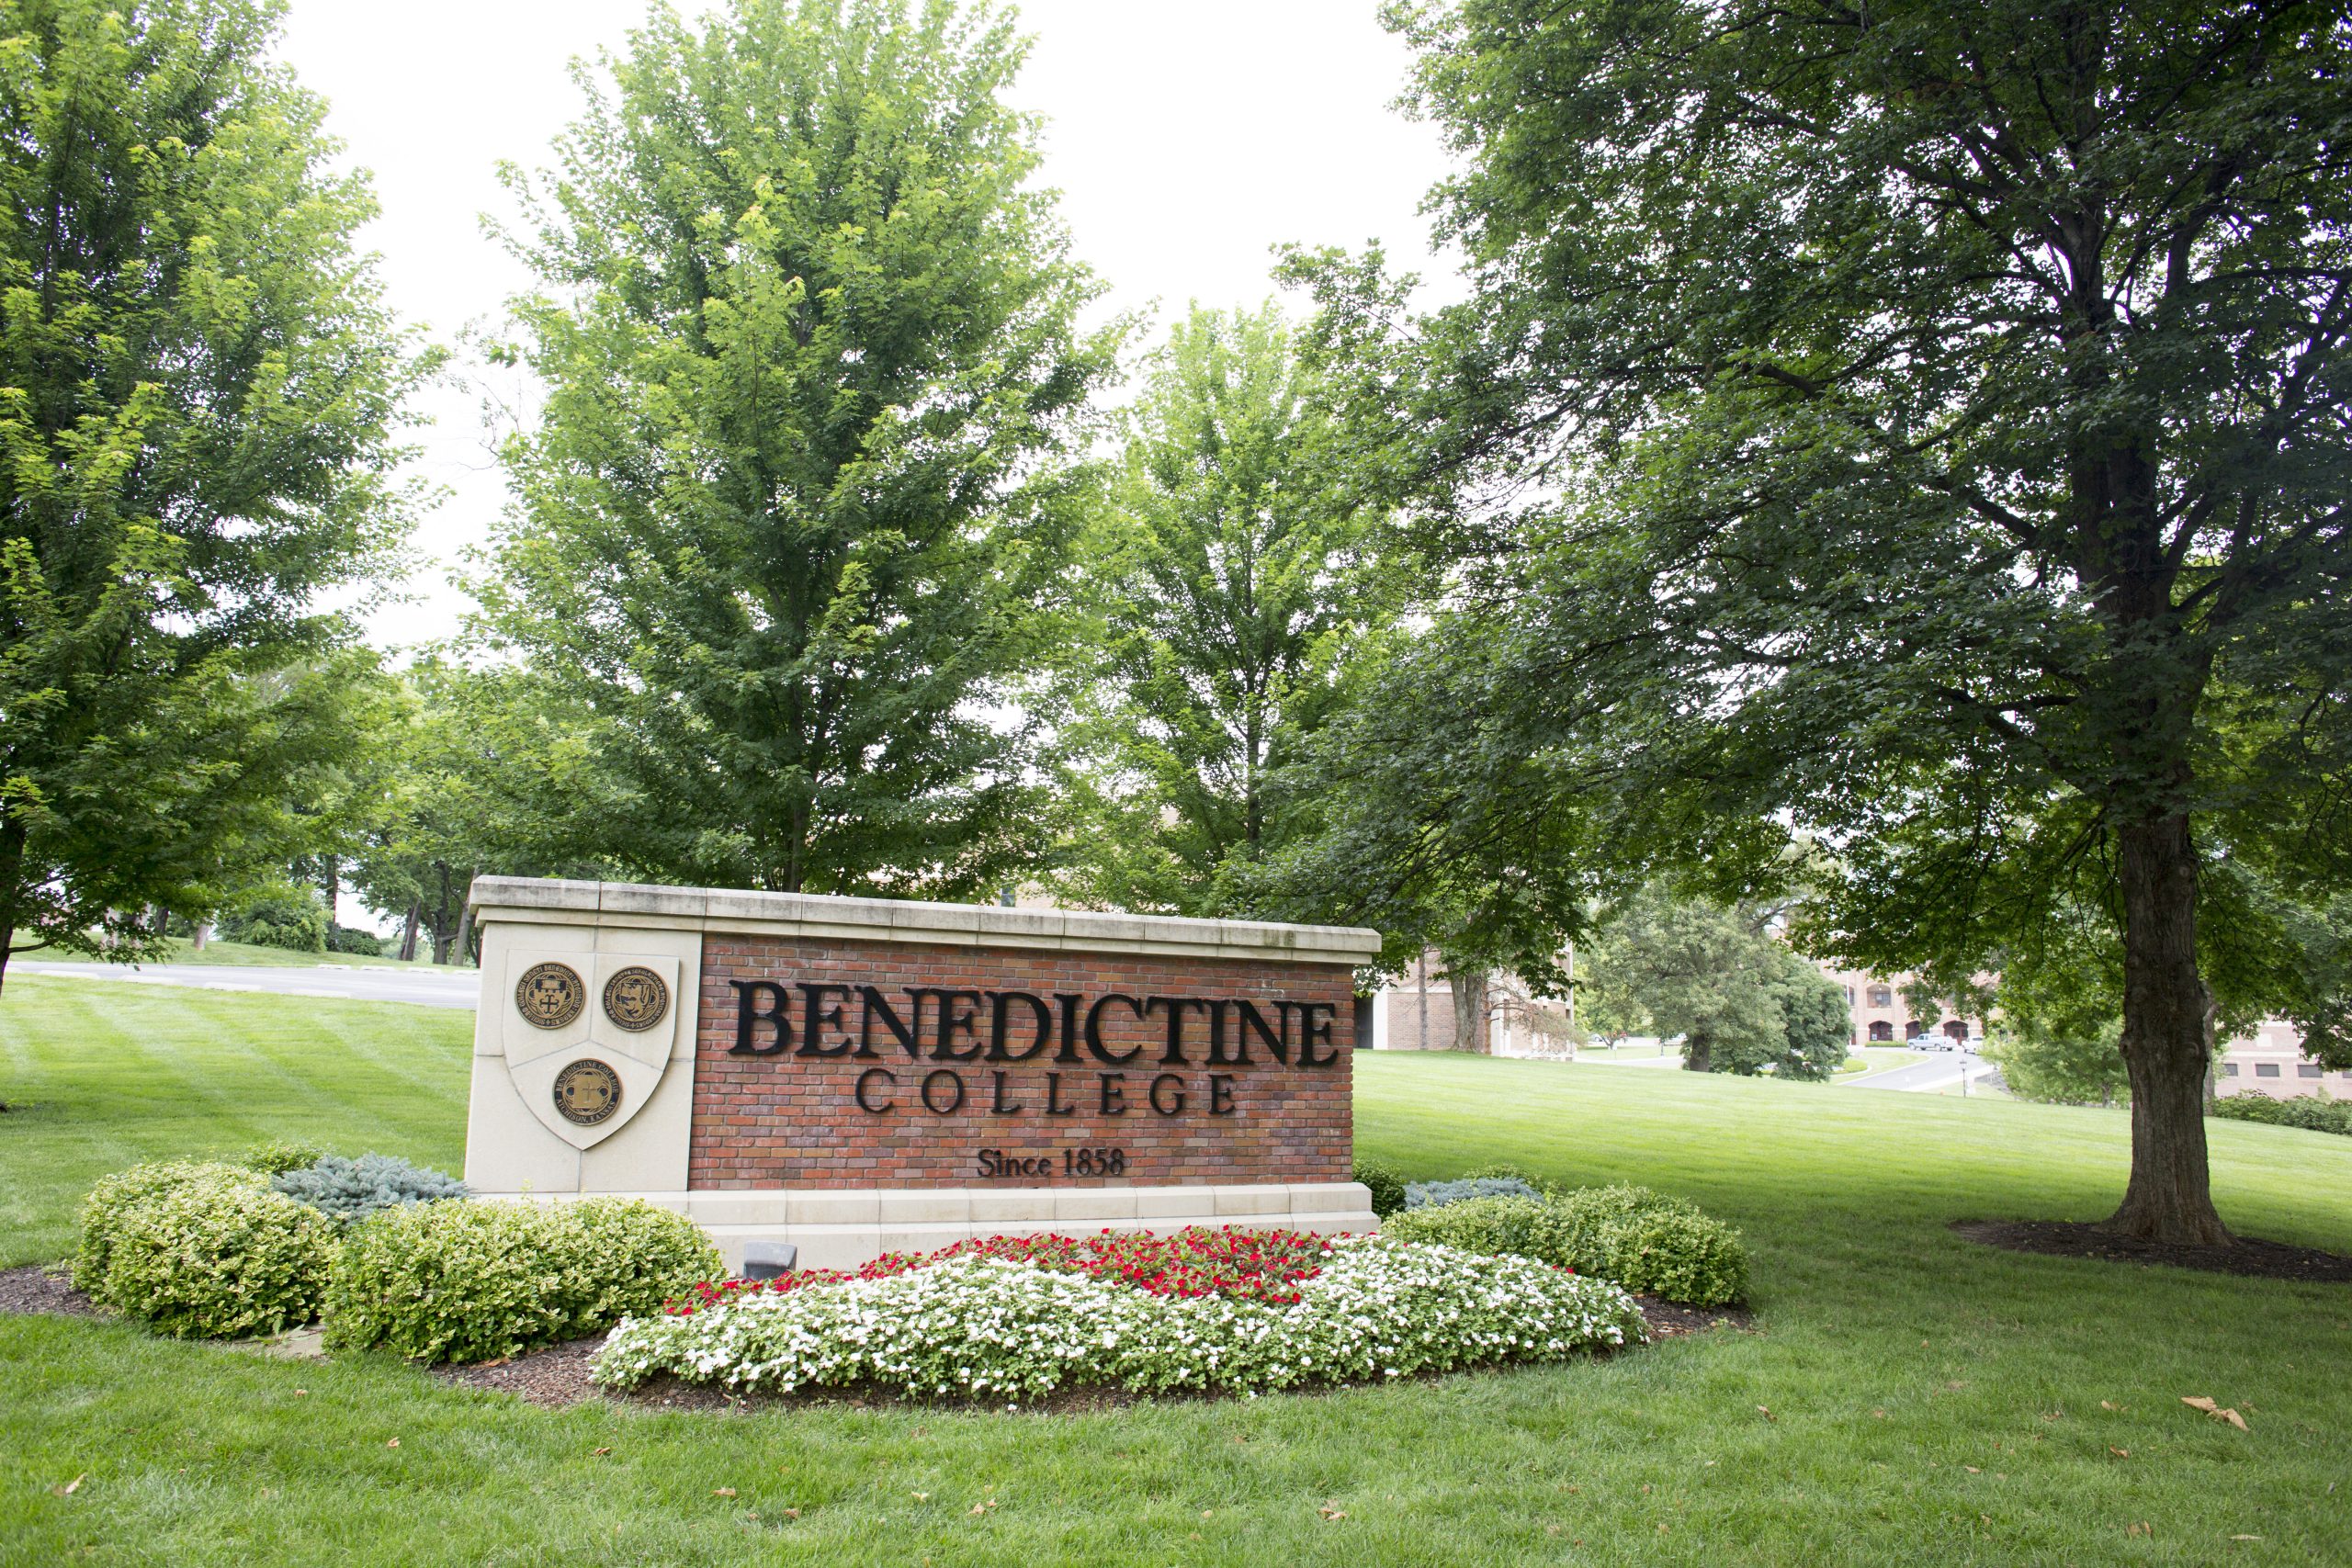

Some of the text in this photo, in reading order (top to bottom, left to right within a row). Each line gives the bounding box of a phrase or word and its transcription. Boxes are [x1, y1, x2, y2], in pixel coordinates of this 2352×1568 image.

[729, 979, 1339, 1066] BENEDICTINE
[556, 1061, 619, 1094] BENEDICTINE COLLEGE
[855, 1068, 1236, 1115] COLLEGE
[978, 1148, 1125, 1178] Since 1858
